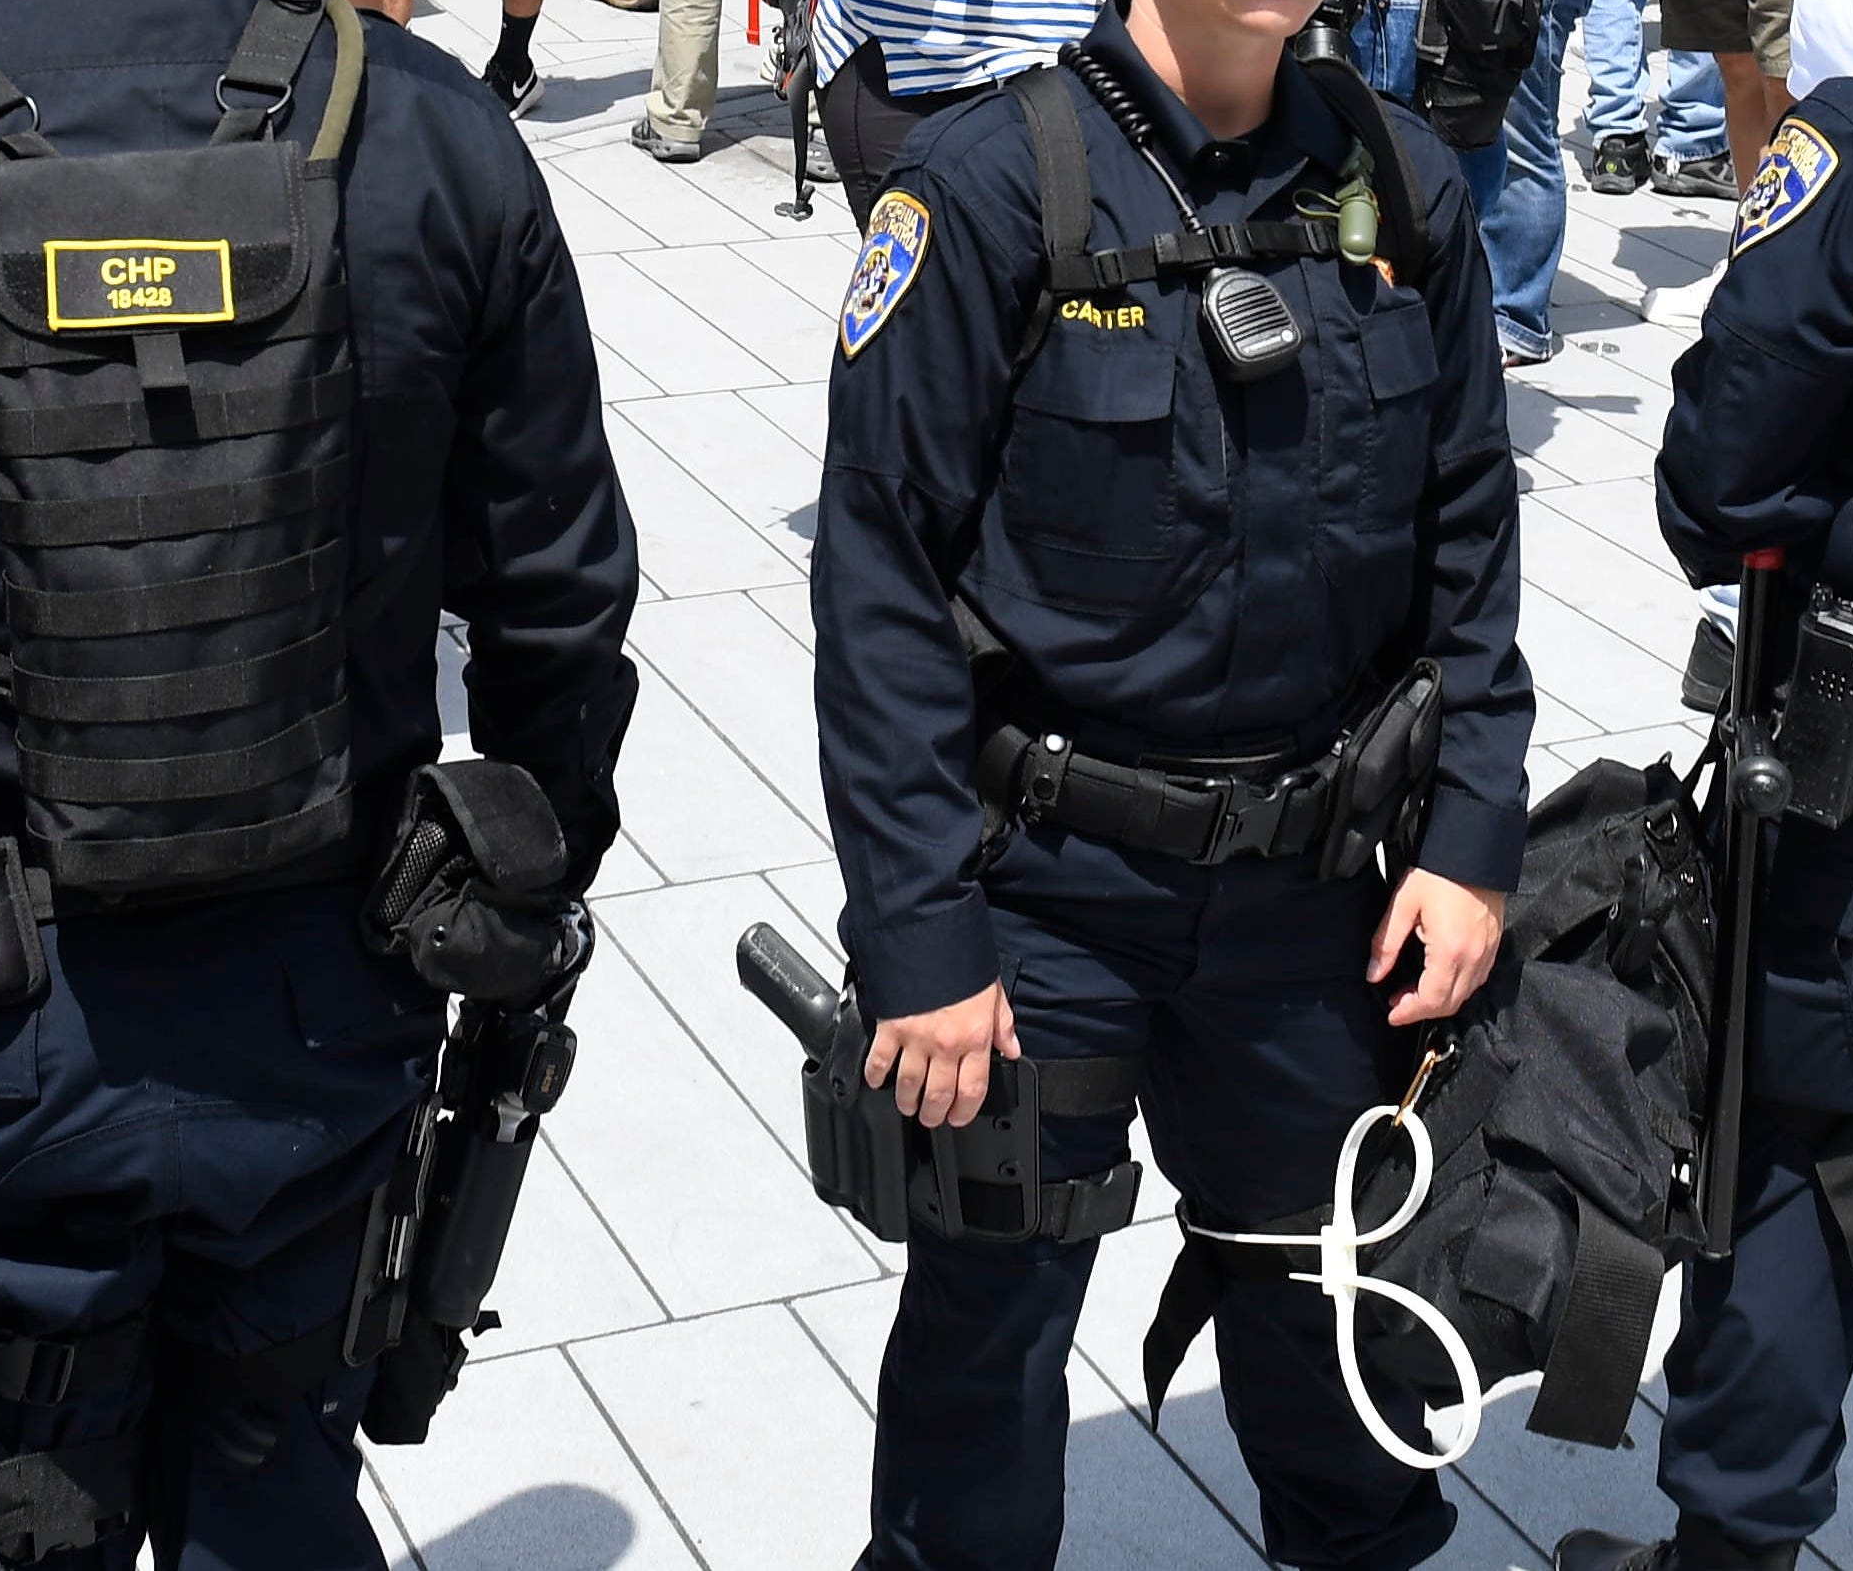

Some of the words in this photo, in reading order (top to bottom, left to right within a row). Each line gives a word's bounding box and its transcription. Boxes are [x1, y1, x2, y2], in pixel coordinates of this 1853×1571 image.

[101, 257, 176, 285] CHP
[107, 287, 172, 309] 18428
[1062, 299, 1145, 329] CARTER
